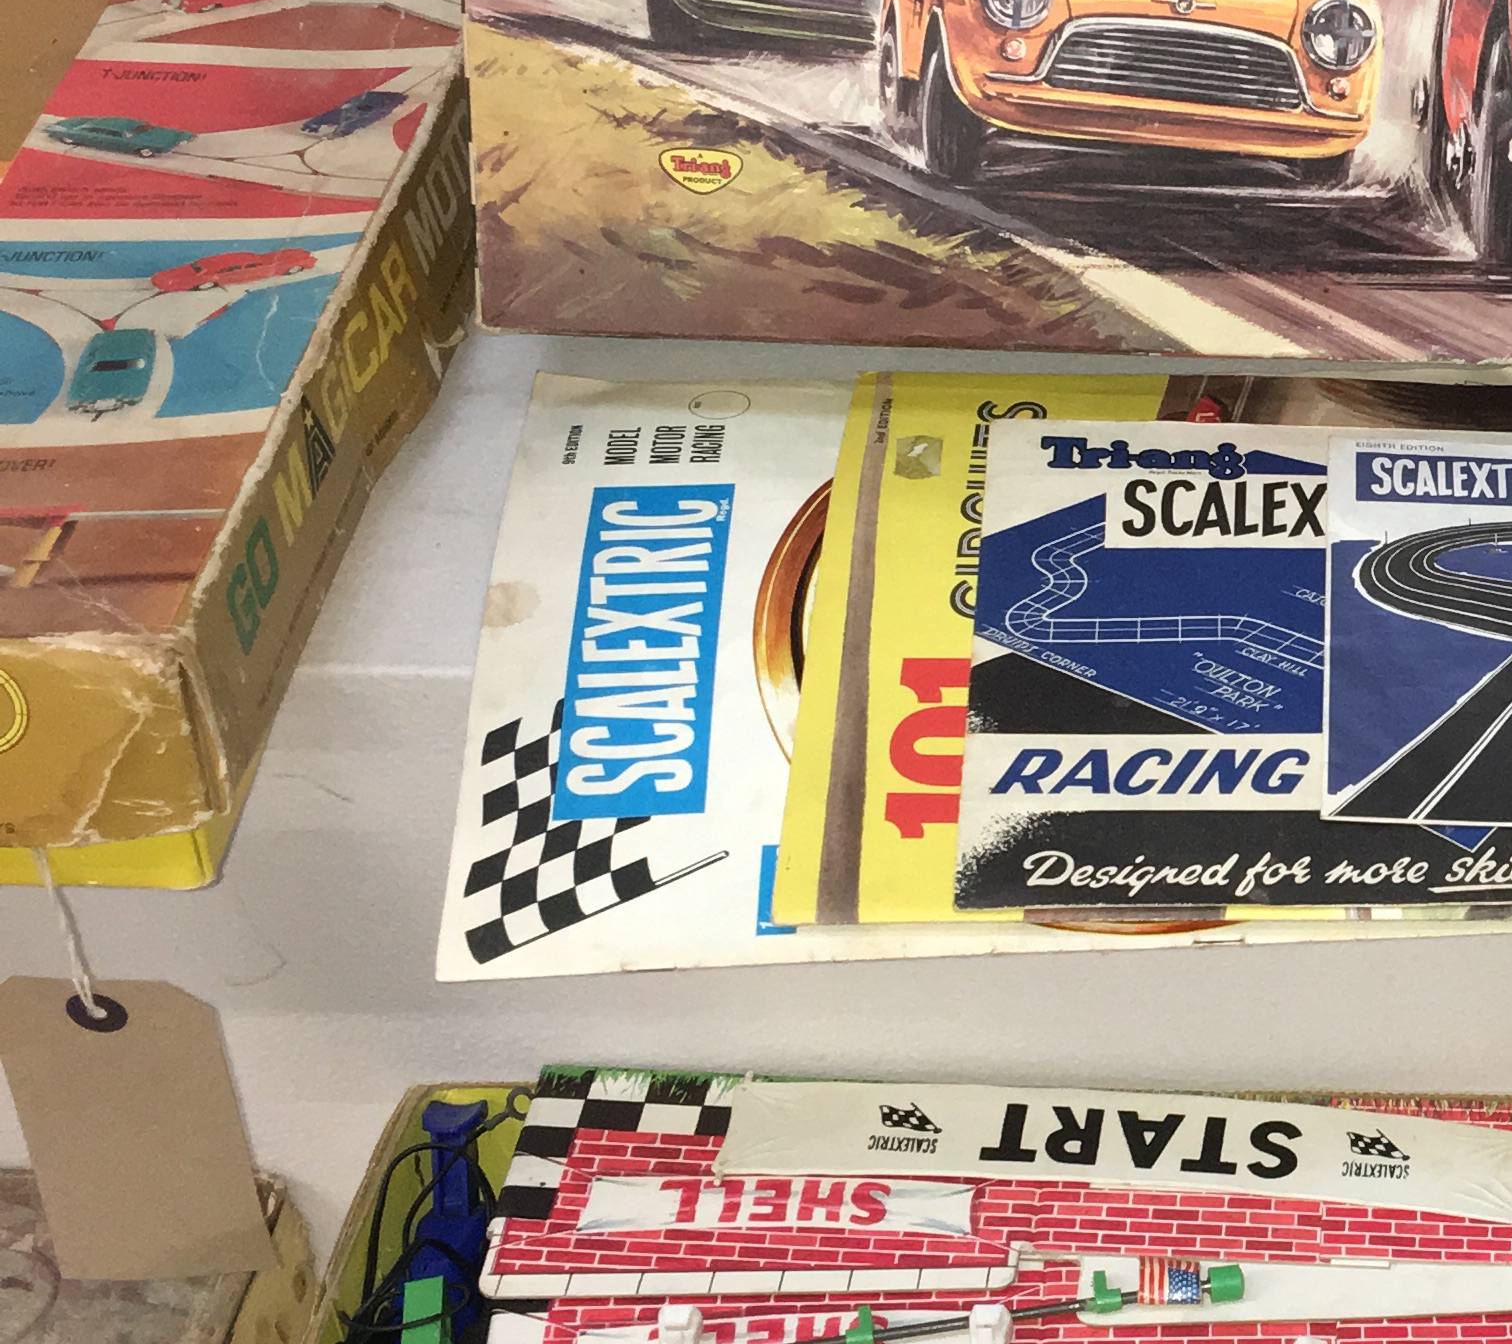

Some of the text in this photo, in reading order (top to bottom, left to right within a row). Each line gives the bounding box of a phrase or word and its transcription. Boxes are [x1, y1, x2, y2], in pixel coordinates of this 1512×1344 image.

[682, 175, 723, 185] PRODUCT
[603, 426, 642, 466] MODEL
[648, 425, 688, 465] MOTOR
[688, 424, 726, 464] RACING
[1355, 441, 1445, 453] EIGHTH EDITION
[1121, 478, 1328, 538] SCALEX
[226, 515, 280, 656] GO
[565, 500, 720, 796] SCALEXTRIC
[1040, 650, 1098, 679] CORNER
[1277, 659, 1308, 678] HILL
[990, 748, 1311, 797] RACING
[1022, 850, 1242, 900] Designed
[1241, 851, 1312, 898] for
[1325, 858, 1428, 886] more
[867, 1101, 1412, 1181] SCALEXTRIC START SCALEXTRIC
[659, 1178, 892, 1226] SHELL
